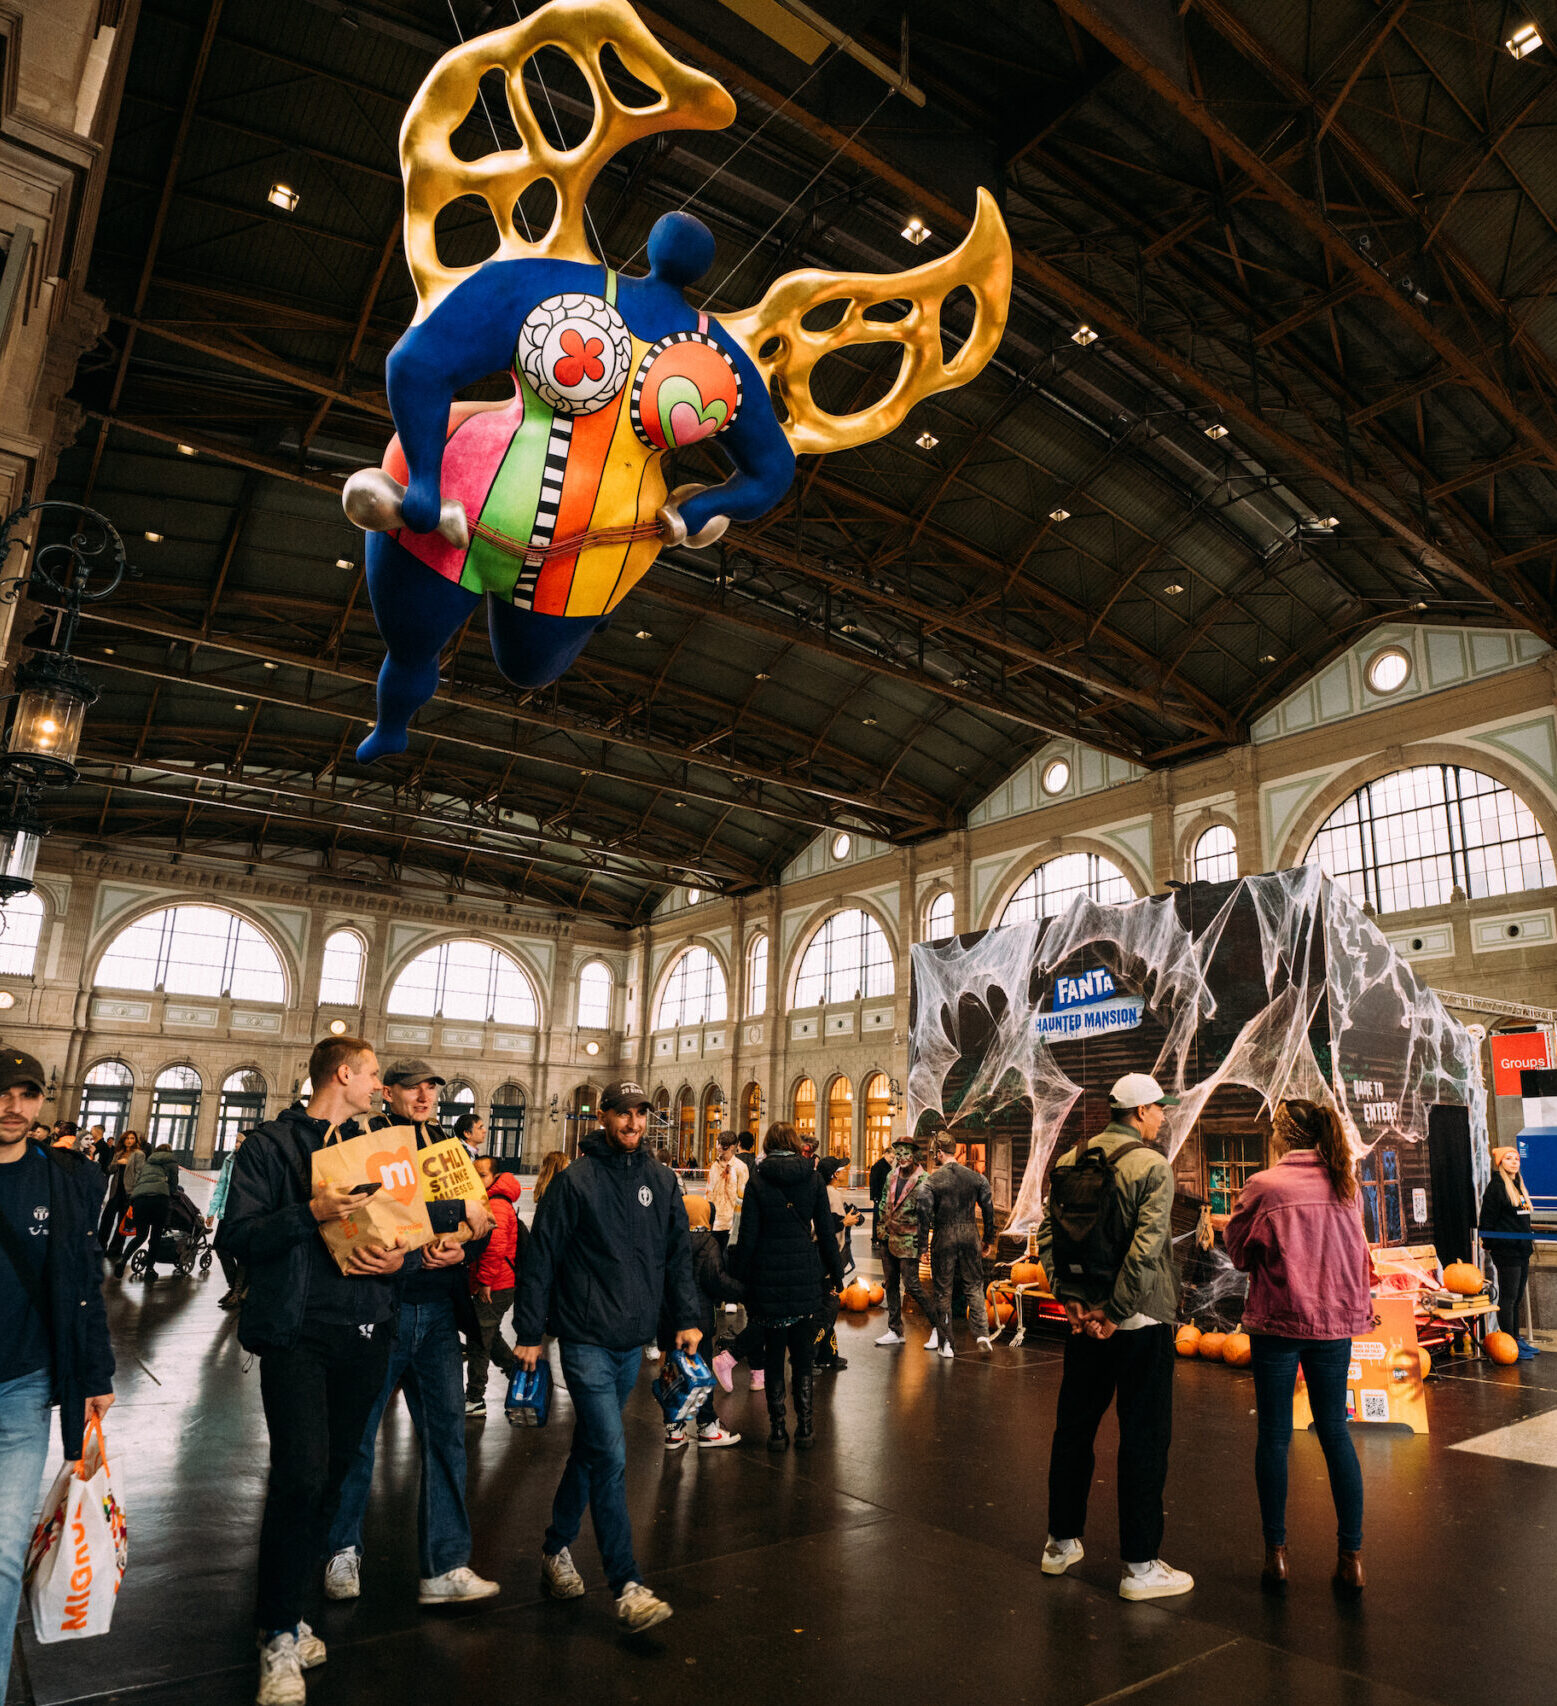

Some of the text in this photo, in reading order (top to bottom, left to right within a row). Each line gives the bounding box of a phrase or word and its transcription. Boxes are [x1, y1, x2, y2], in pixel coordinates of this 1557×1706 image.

[1057, 970, 1114, 1004] FANTA
[1035, 1007, 1137, 1033] HAUNTED MANSION
[1500, 1057, 1546, 1071] Groups
[1353, 1079, 1384, 1102] DARE TO
[1363, 1101, 1398, 1128] ENTER?
[422, 1148, 464, 1178] CHLI
[429, 1168, 470, 1193] STINKE
